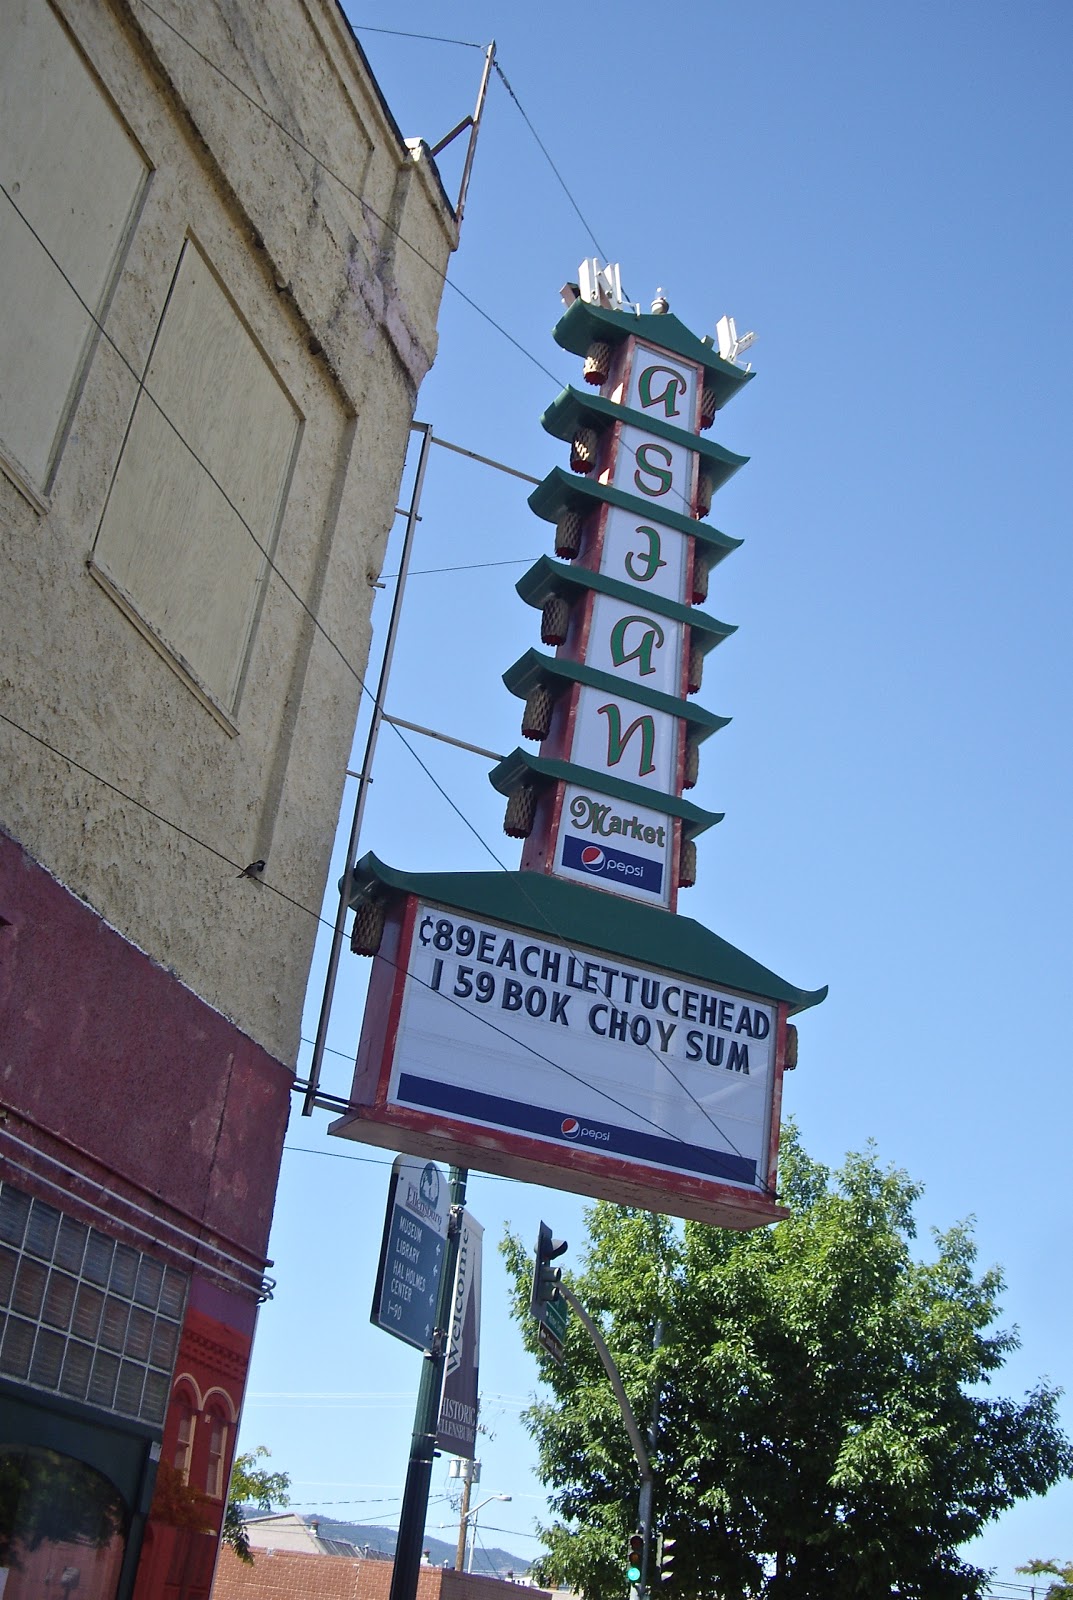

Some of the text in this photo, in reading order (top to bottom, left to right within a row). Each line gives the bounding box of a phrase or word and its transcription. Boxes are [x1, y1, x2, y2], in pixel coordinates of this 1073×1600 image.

[570, 795, 665, 848] Market
[607, 859, 644, 877] pepsi
[502, 978, 571, 1026] BOK
[588, 1003, 677, 1053] CHOY
[686, 1030, 750, 1075] SUM
[581, 1128, 610, 1141] pepsi
[400, 1216, 423, 1243] MUSEUM
[395, 1238, 420, 1264] LIBRARY
[392, 1260, 426, 1292] HAL HOLMES
[391, 1278, 412, 1302] CENTER
